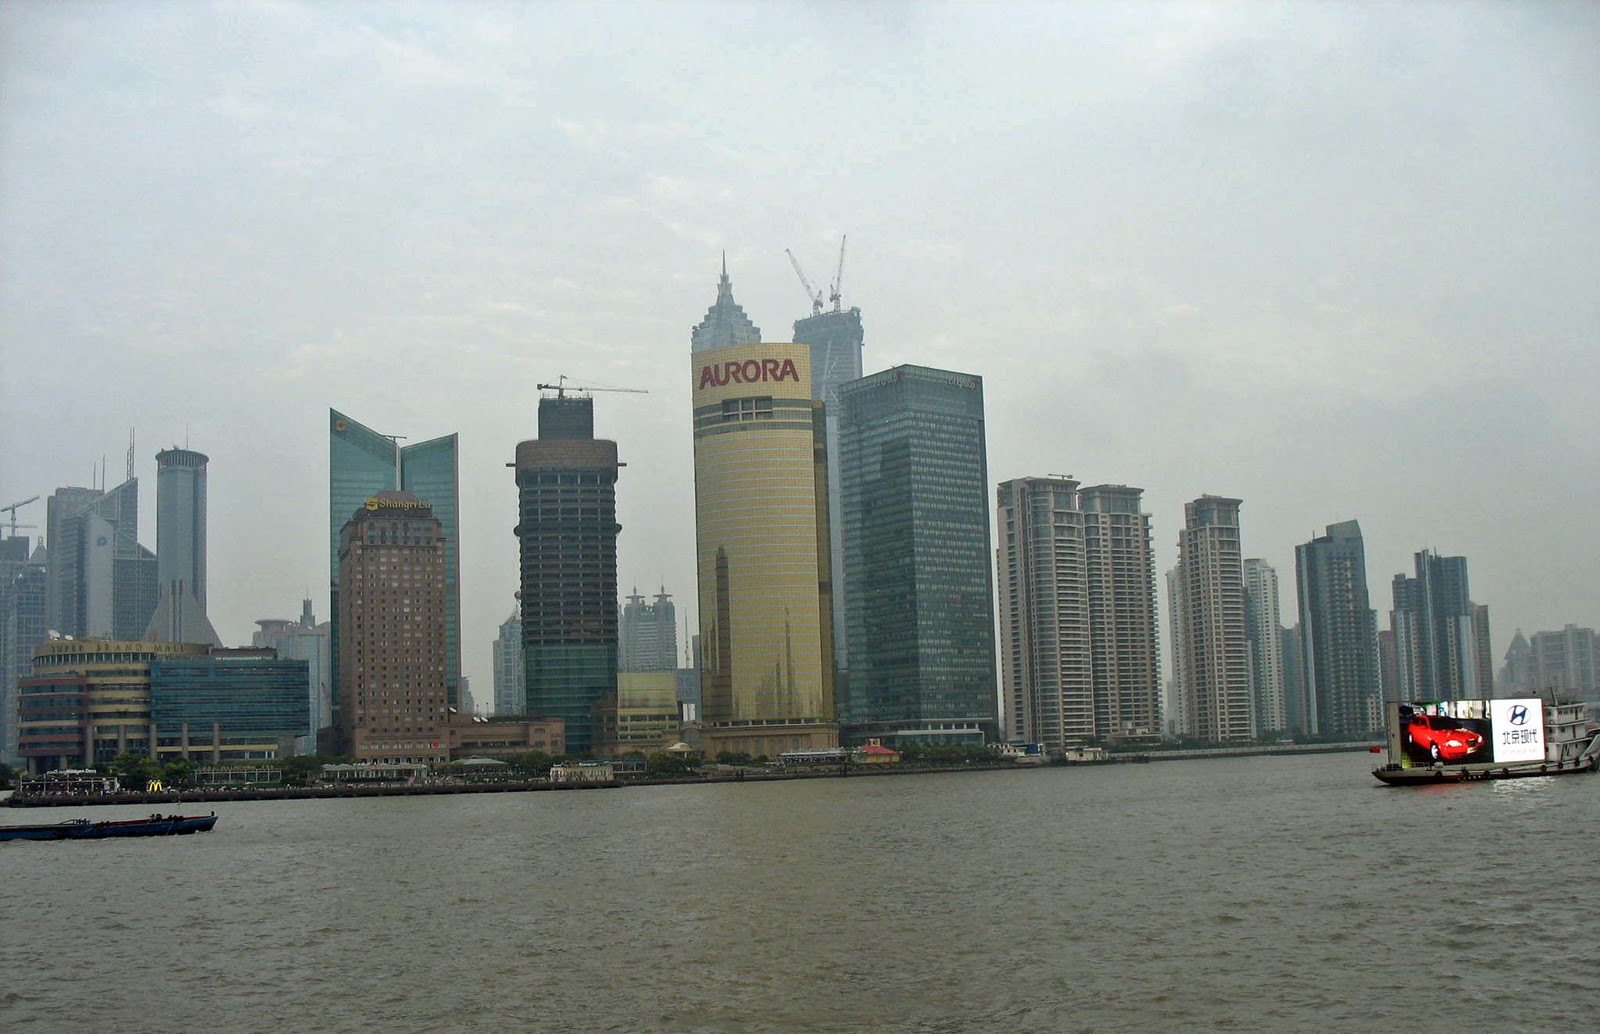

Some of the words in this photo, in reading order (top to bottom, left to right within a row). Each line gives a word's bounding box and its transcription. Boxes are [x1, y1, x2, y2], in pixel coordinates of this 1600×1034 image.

[699, 359, 799, 390] AURORA
[51, 645, 84, 653] SUPER
[96, 644, 143, 652] BRAND
[153, 644, 184, 652] MALL
[1502, 729, 1538, 745] 北京现代
